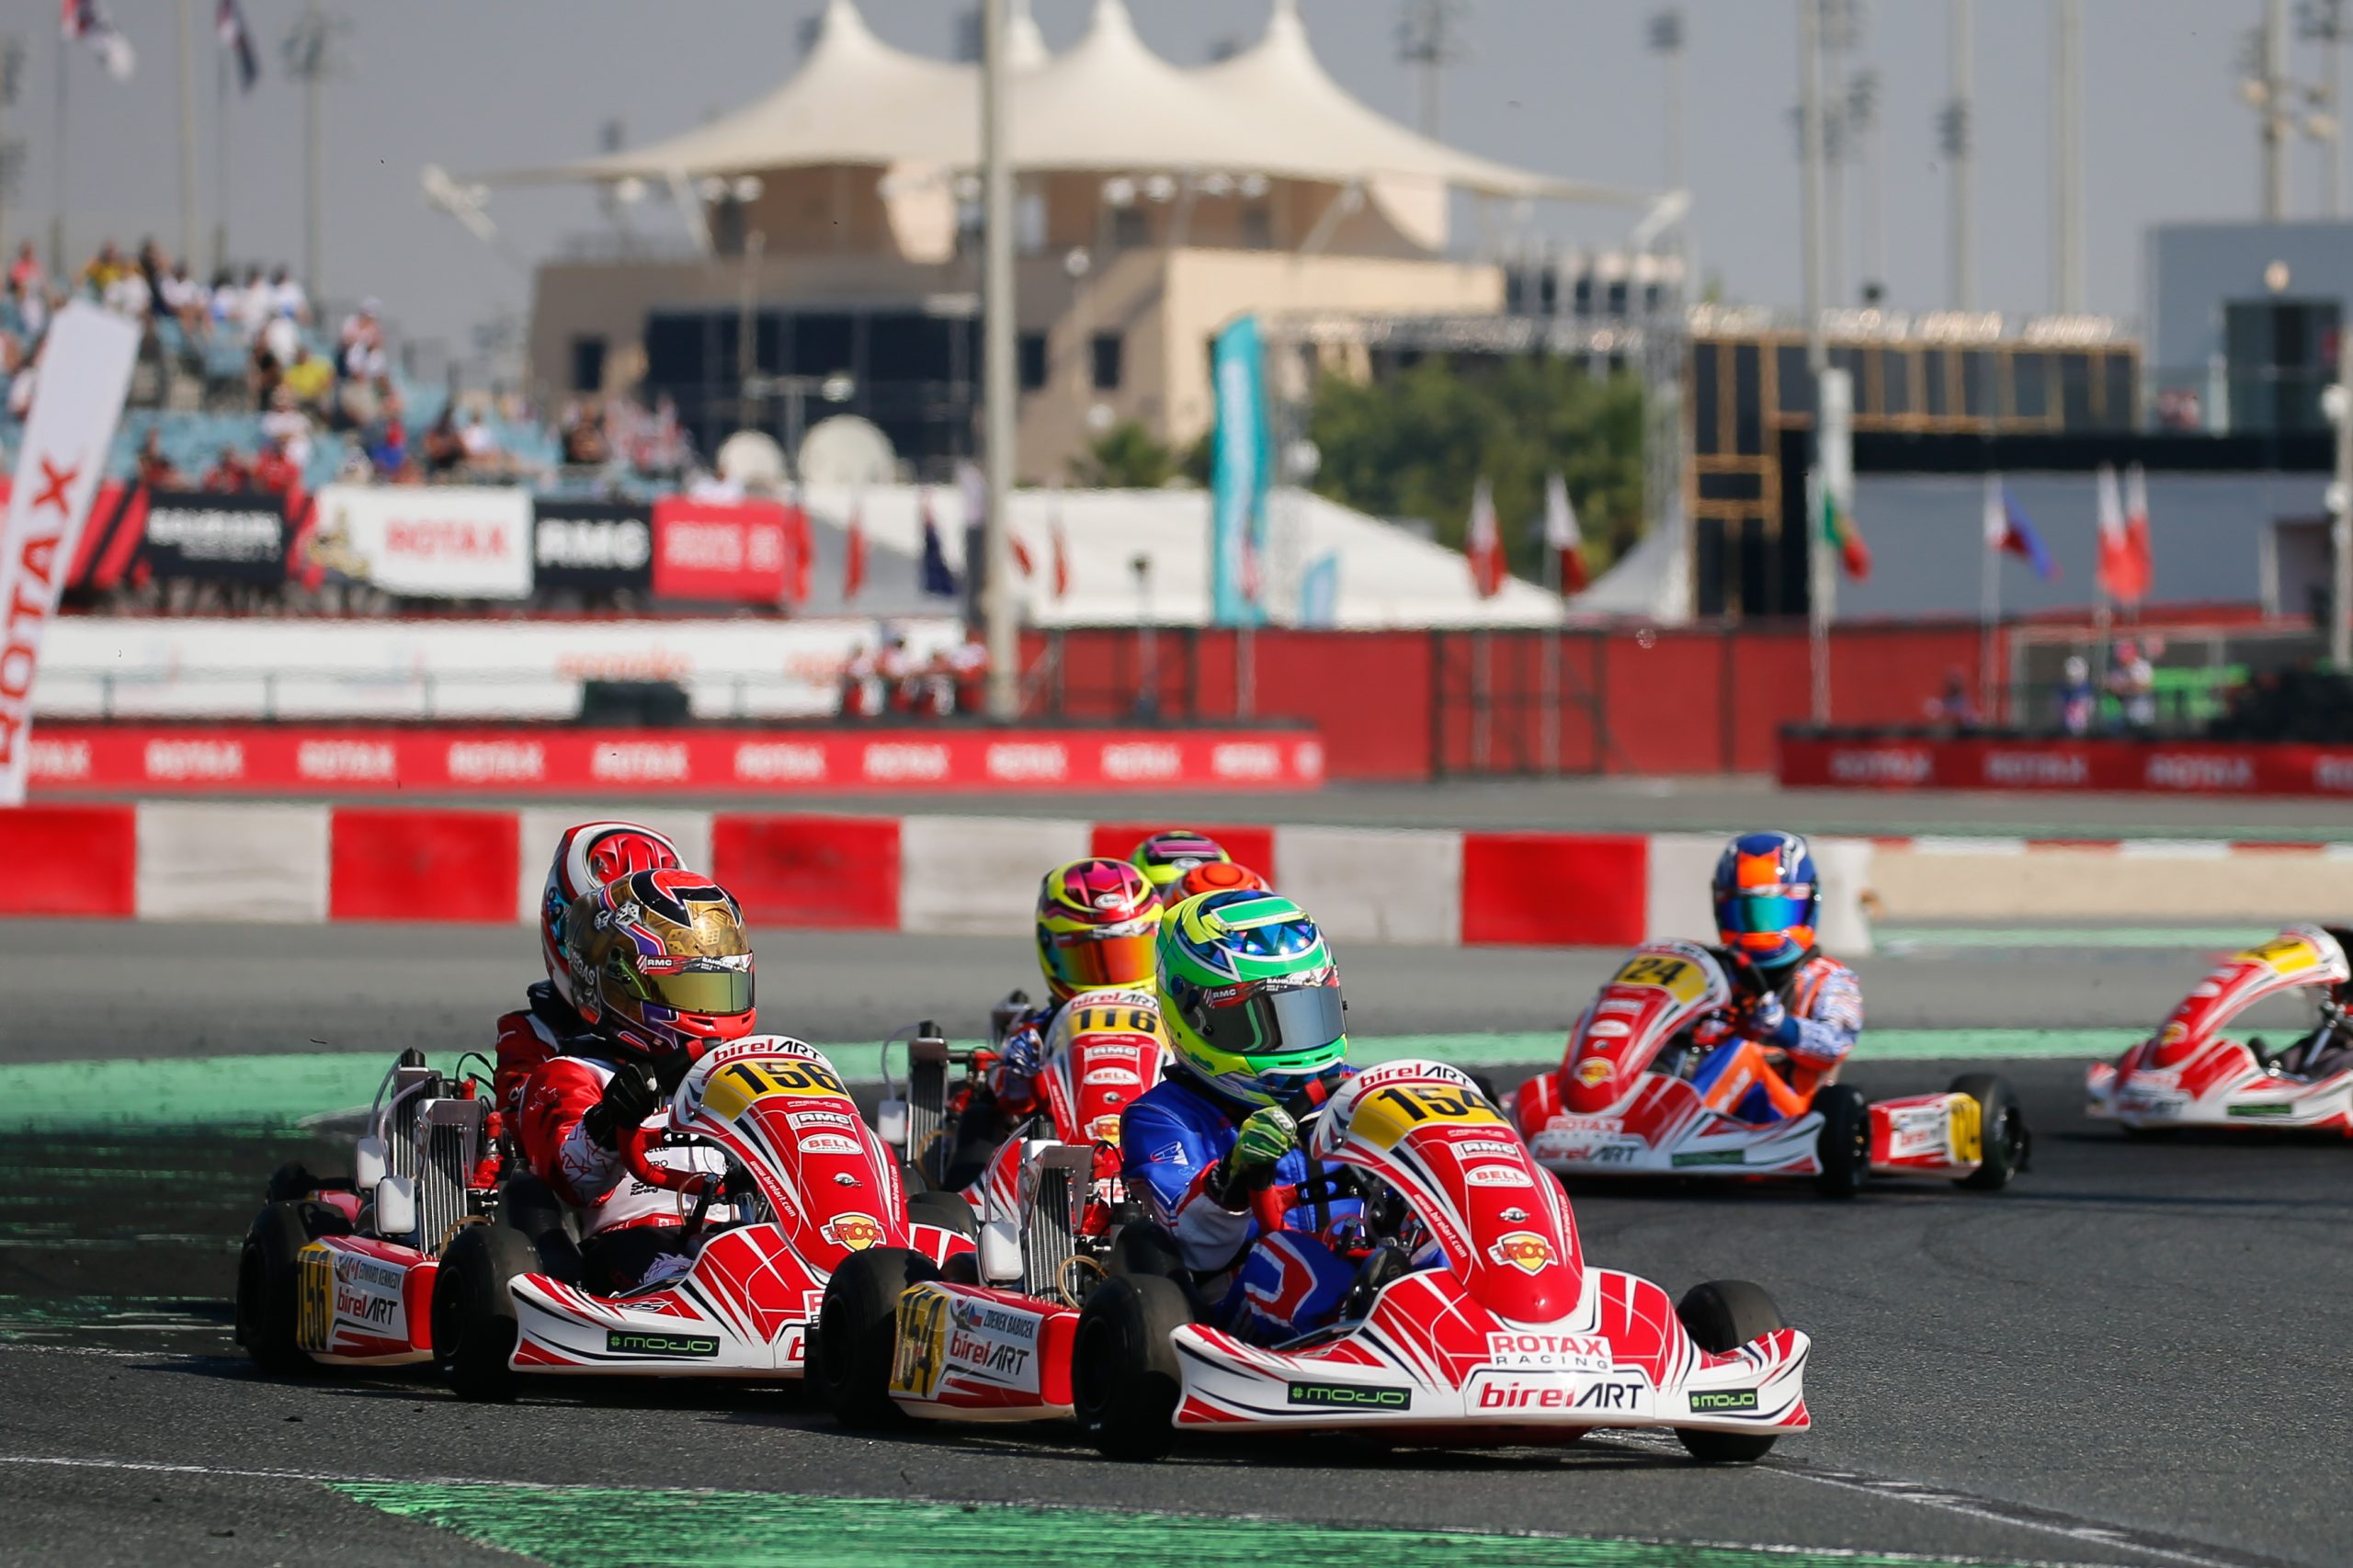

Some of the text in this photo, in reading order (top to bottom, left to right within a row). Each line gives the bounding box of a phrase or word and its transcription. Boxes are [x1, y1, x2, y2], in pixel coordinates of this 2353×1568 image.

[647, 959, 673, 967] RMC
[1212, 989, 1237, 999] RMC
[1074, 1008, 1156, 1033] 116
[713, 1039, 824, 1063] birelART
[724, 1062, 848, 1096] 156
[1093, 1072, 1131, 1081] BELL
[1359, 1063, 1471, 1088] birelART
[1377, 1087, 1506, 1121] 154
[801, 1113, 850, 1125] RMC
[807, 1140, 854, 1149] BELL
[1464, 1142, 1517, 1154] RMC
[1475, 1170, 1525, 1182] BELL
[750, 1160, 797, 1218] www.birelart.com
[1413, 1193, 1468, 1258] www.birelart.com
[337, 1286, 398, 1325] birelART
[949, 1330, 1030, 1376] birelART
[1492, 1335, 1606, 1358] ROTAX
[1495, 1355, 1608, 1369] RACING
[1479, 1381, 1644, 1410] birelART
